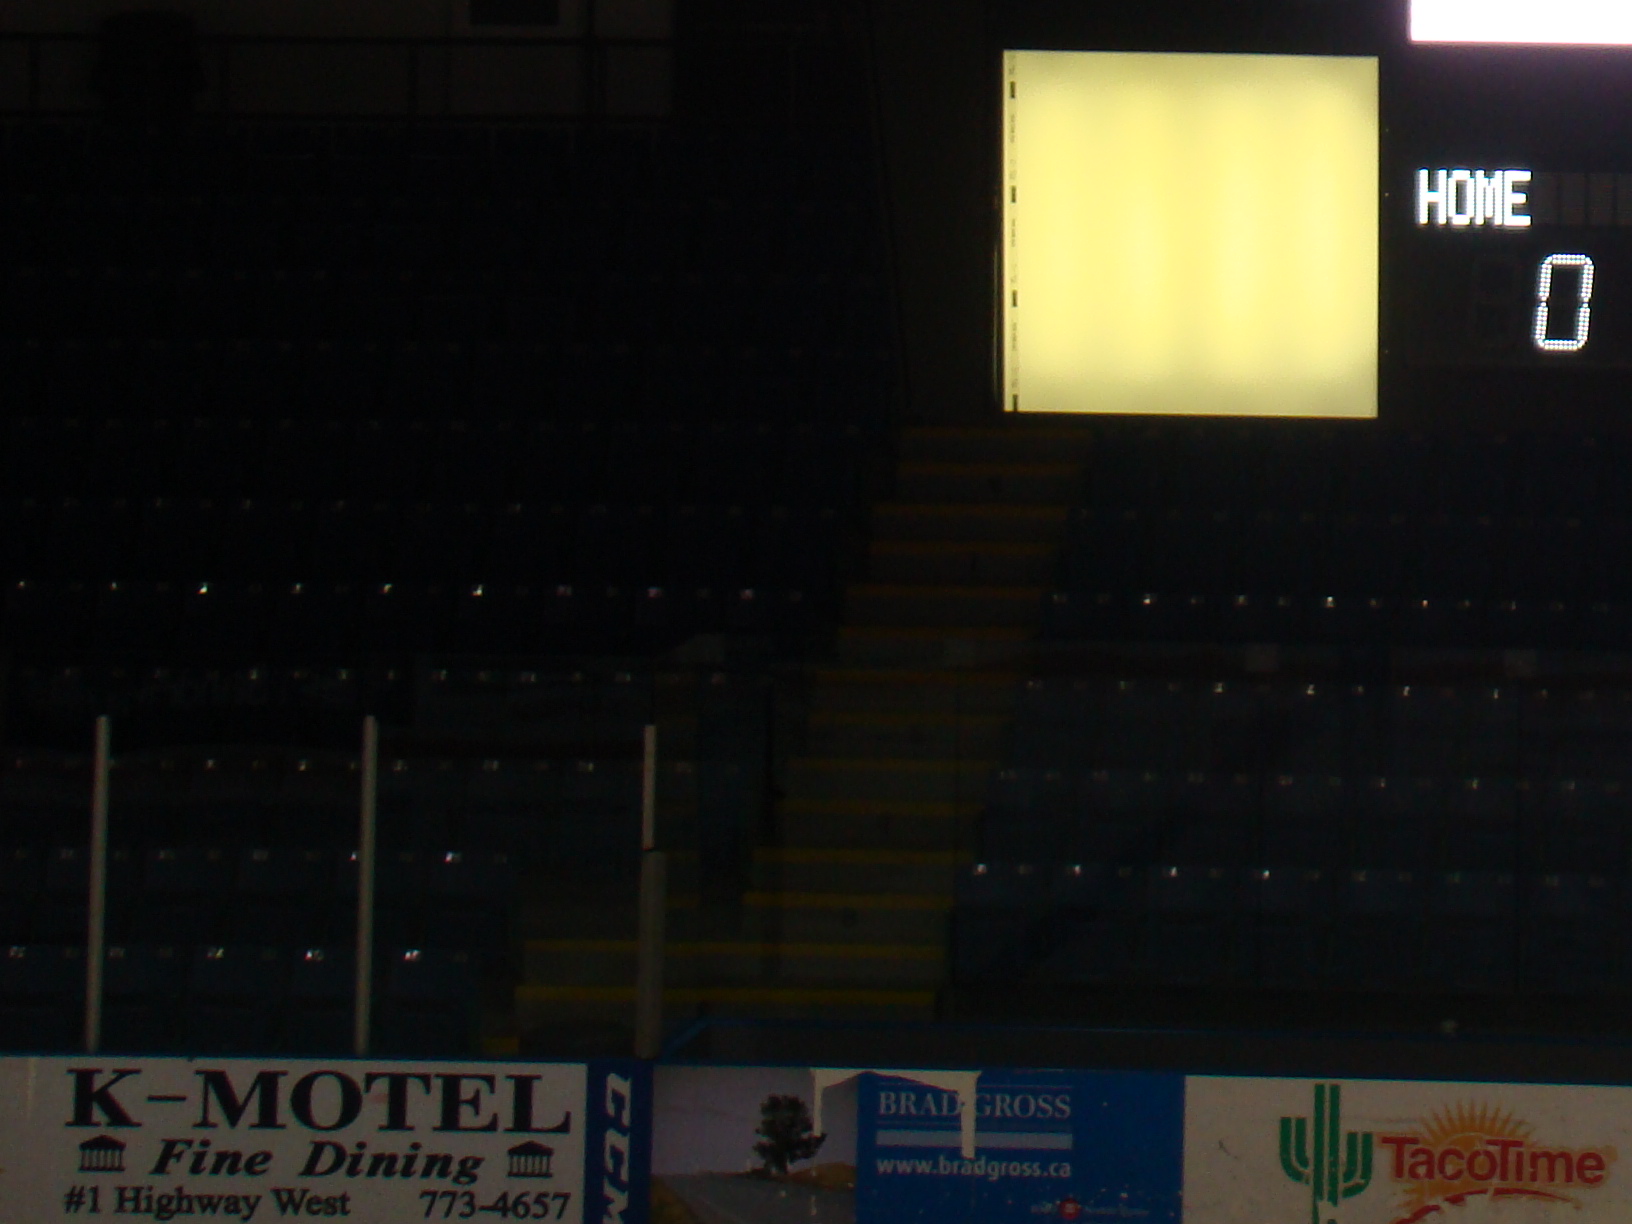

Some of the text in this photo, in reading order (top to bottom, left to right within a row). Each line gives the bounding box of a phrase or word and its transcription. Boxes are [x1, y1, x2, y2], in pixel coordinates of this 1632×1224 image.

[1415, 167, 1533, 228] HOME
[1532, 253, 1596, 353] 0
[878, 1090, 1072, 1119] BRAD GROSS
[151, 1138, 485, 1185] Fine Dining
[876, 1154, 1072, 1182] www.bradgross.ca
[1382, 1135, 1606, 1184] TacoTime
[63, 1185, 570, 1219] #1 Highway West 773-4657
